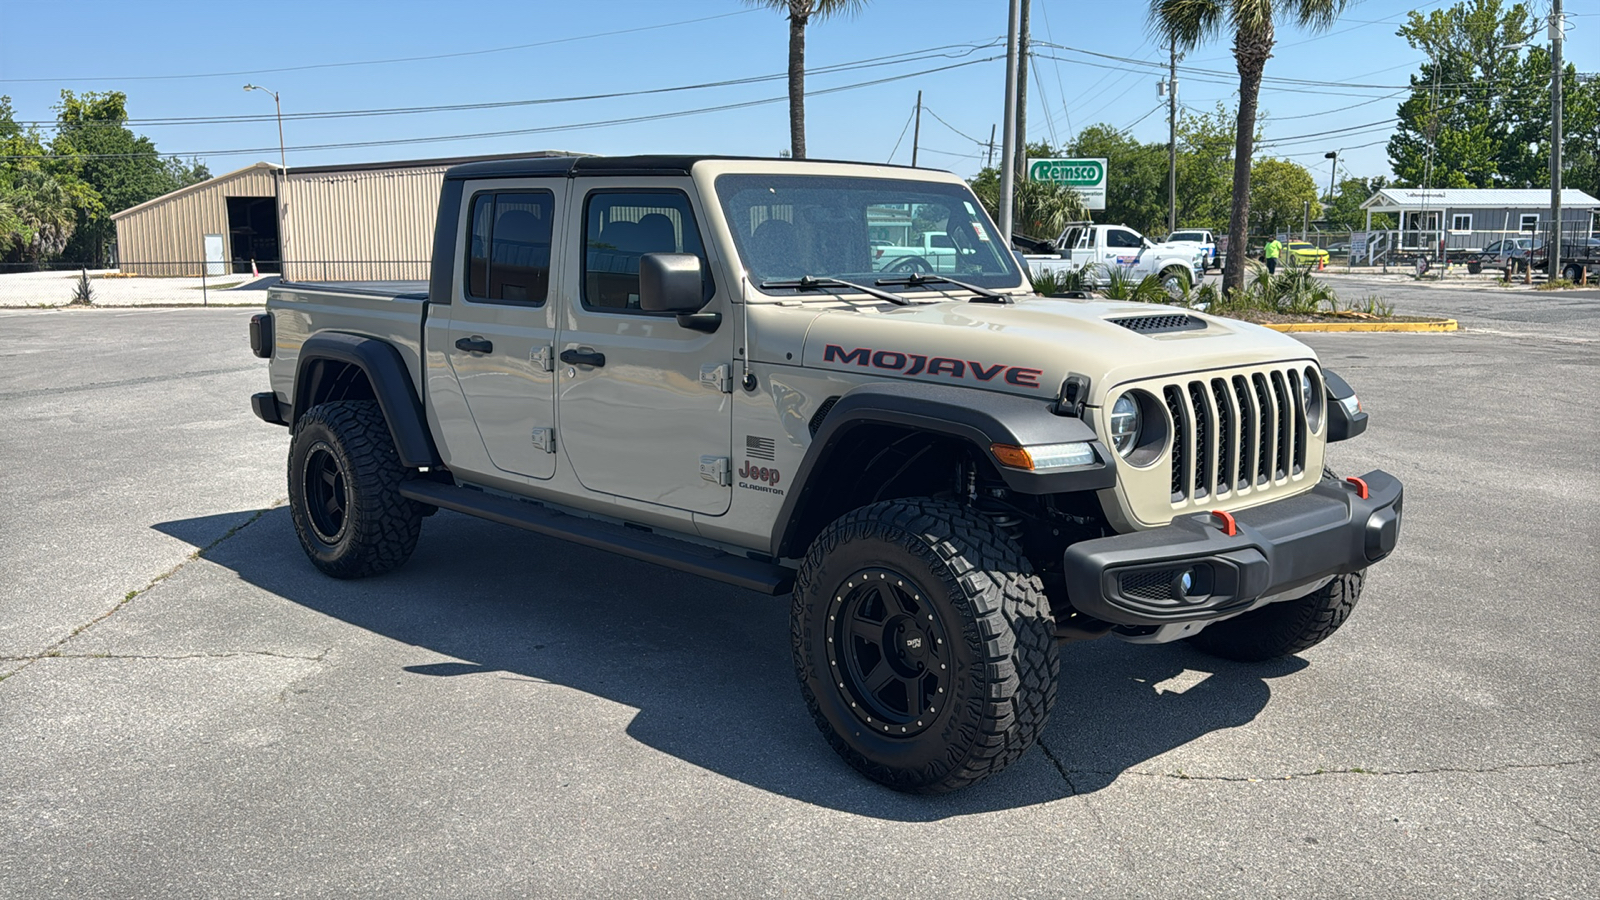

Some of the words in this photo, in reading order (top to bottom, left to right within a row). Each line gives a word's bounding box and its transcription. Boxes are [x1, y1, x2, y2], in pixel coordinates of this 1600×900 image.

[1038, 161, 1097, 180] Remsco
[823, 344, 1043, 388] MOJAVE
[739, 460, 780, 486] Jeep
[739, 481, 784, 495] GLADIATOR
